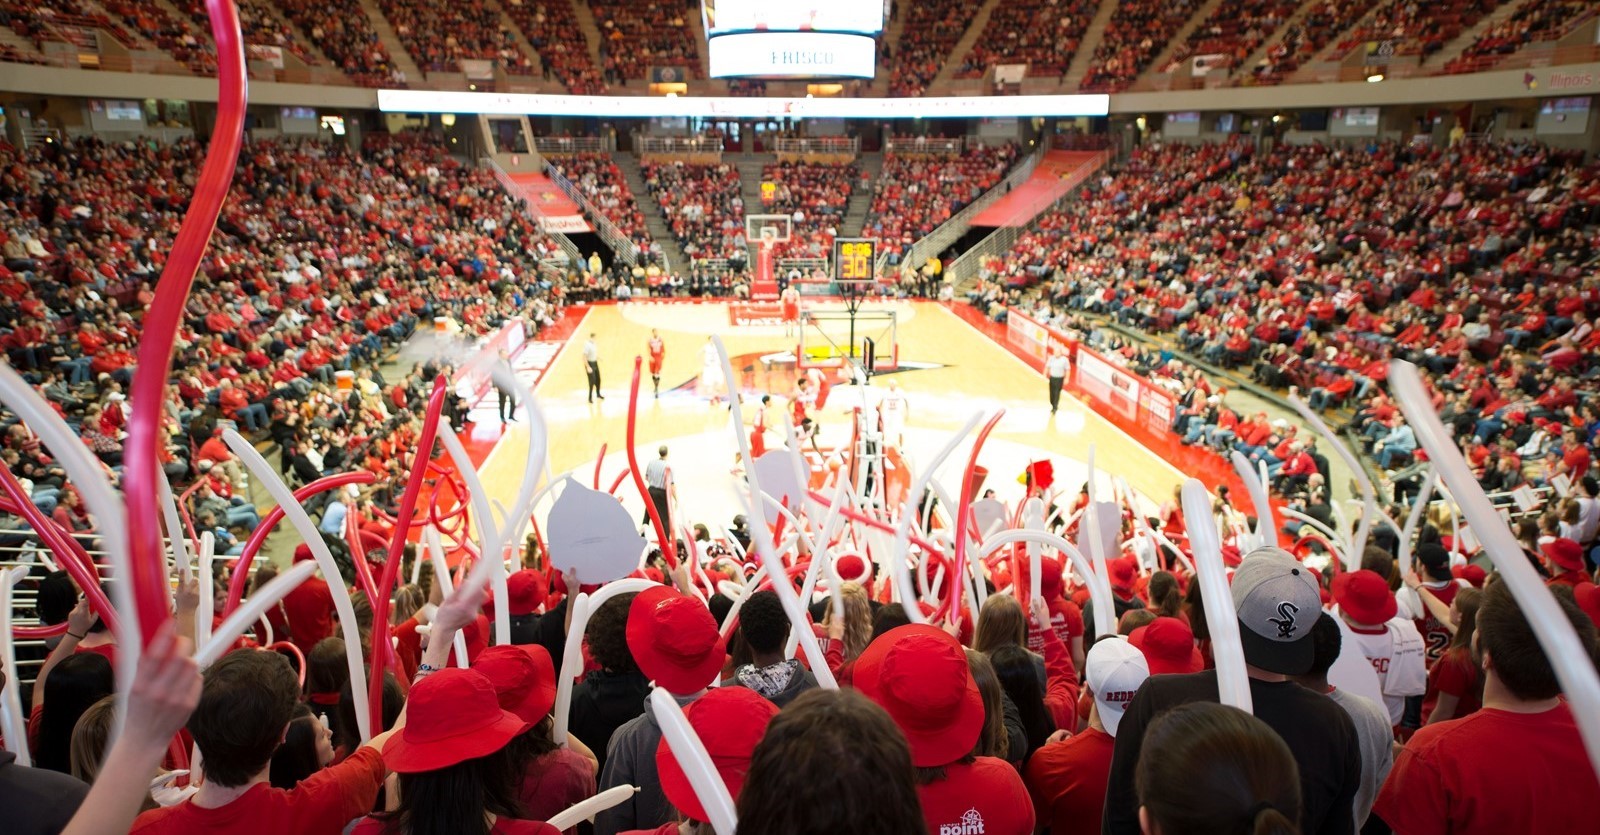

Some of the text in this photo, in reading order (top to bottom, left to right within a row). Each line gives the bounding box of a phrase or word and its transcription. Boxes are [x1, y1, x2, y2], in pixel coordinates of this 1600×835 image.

[768, 51, 835, 65] FRISCO
[1550, 73, 1592, 88] Illinois
[843, 256, 867, 278] 30
[1106, 690, 1137, 701] REDB
[940, 821, 985, 835] point
